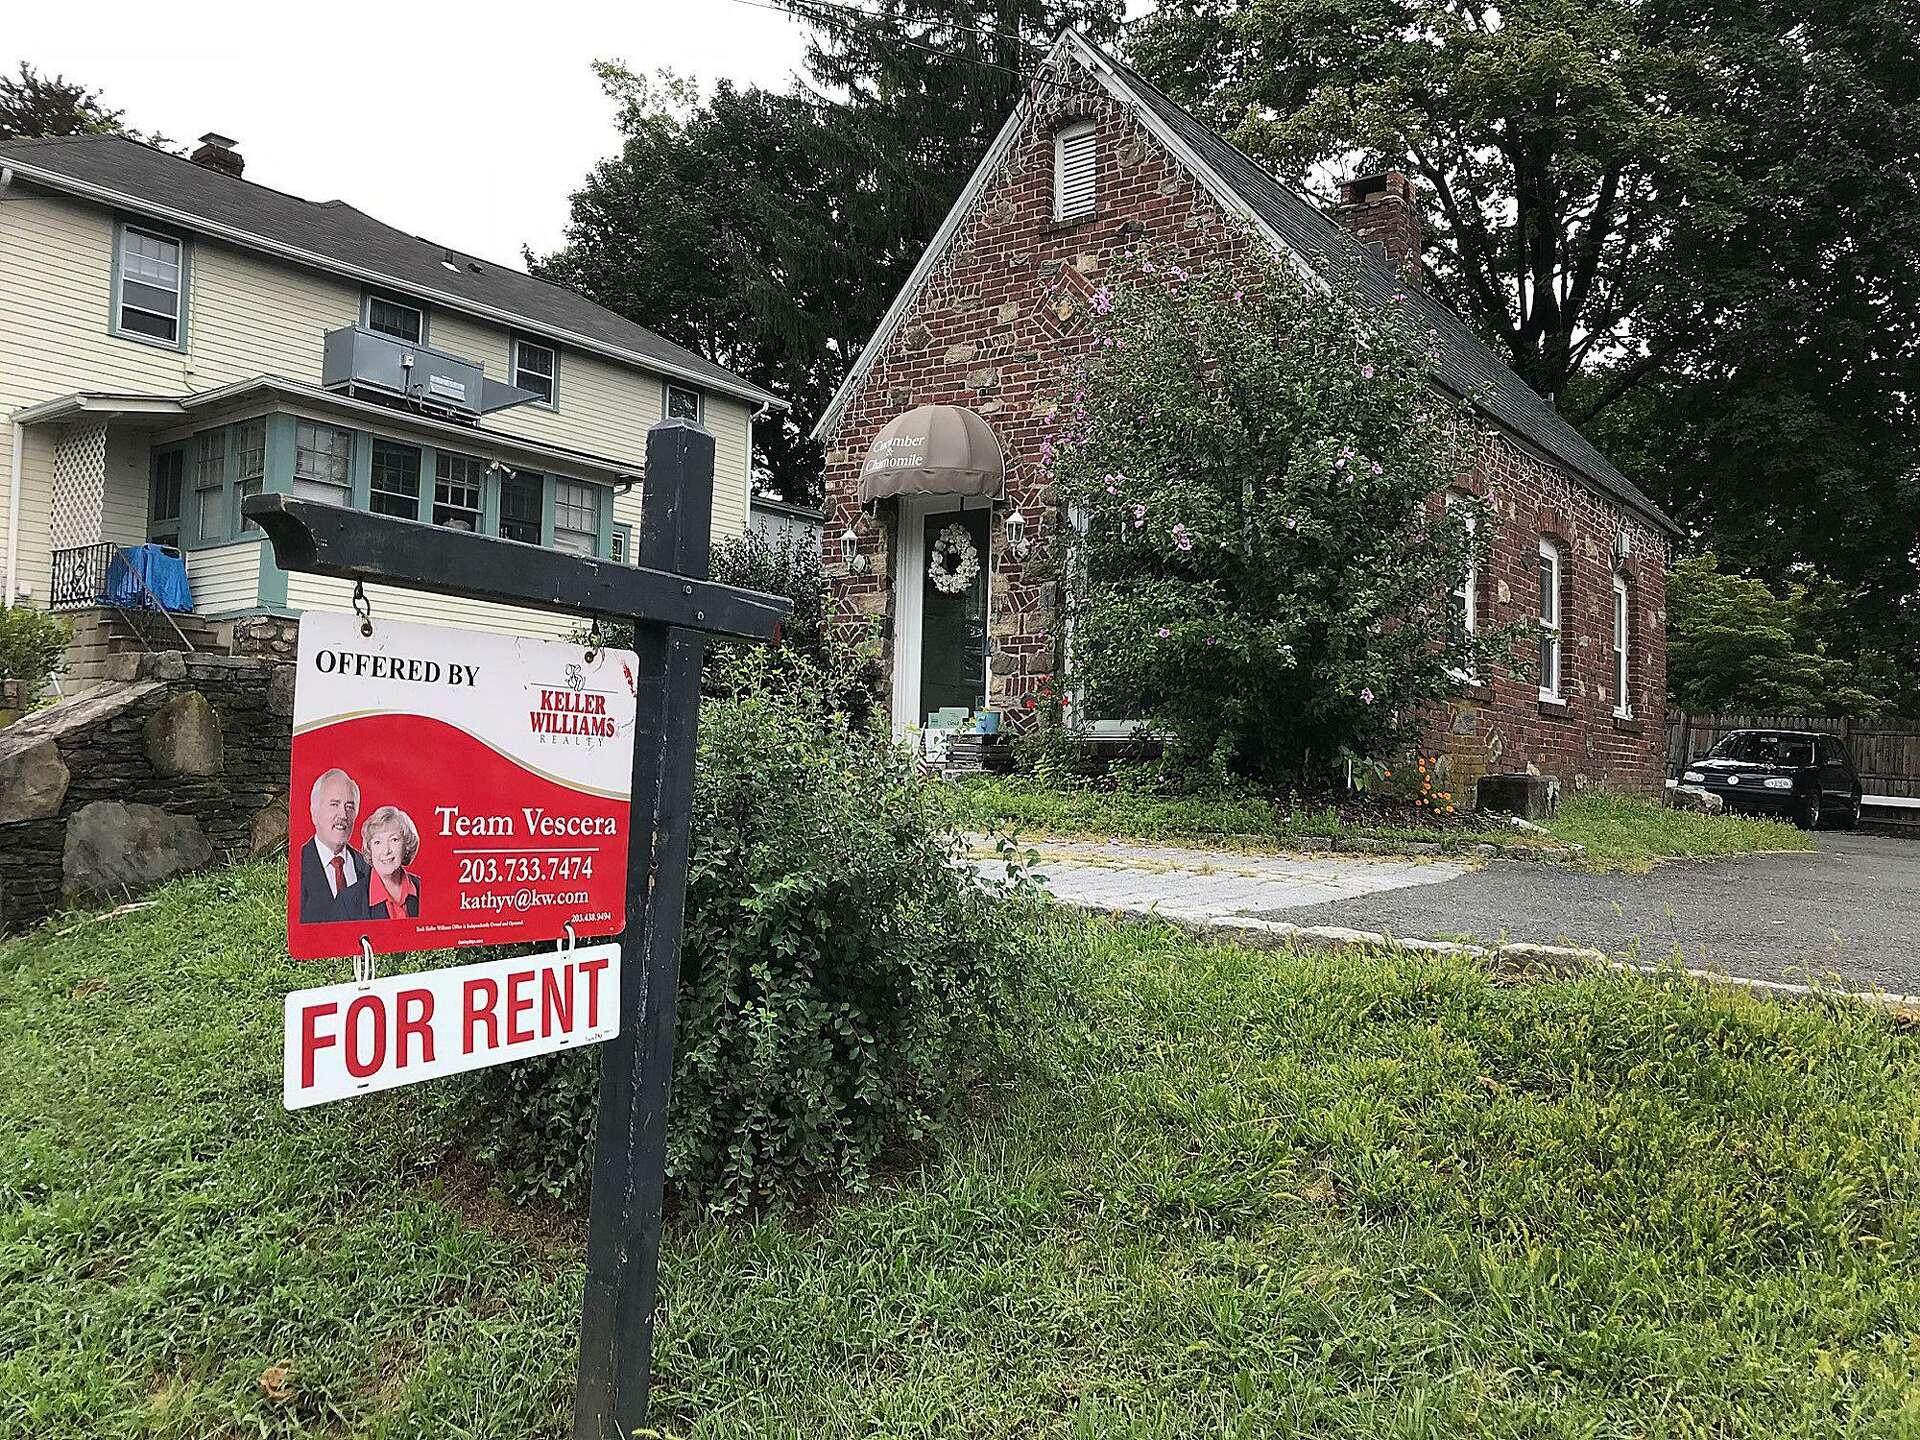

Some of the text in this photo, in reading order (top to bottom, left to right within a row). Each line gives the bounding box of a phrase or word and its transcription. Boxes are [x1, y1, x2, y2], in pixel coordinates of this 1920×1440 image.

[315, 649, 481, 688] OFFERED BY
[540, 689, 607, 716] KELLER
[529, 711, 616, 738] WILLIAMS
[539, 733, 604, 748] REALTY
[434, 806, 617, 837] Team Vescera
[458, 856, 593, 884] 203.733.7474
[459, 888, 589, 914] kathyv@kw.com
[301, 958, 609, 1090] FOR RENT
